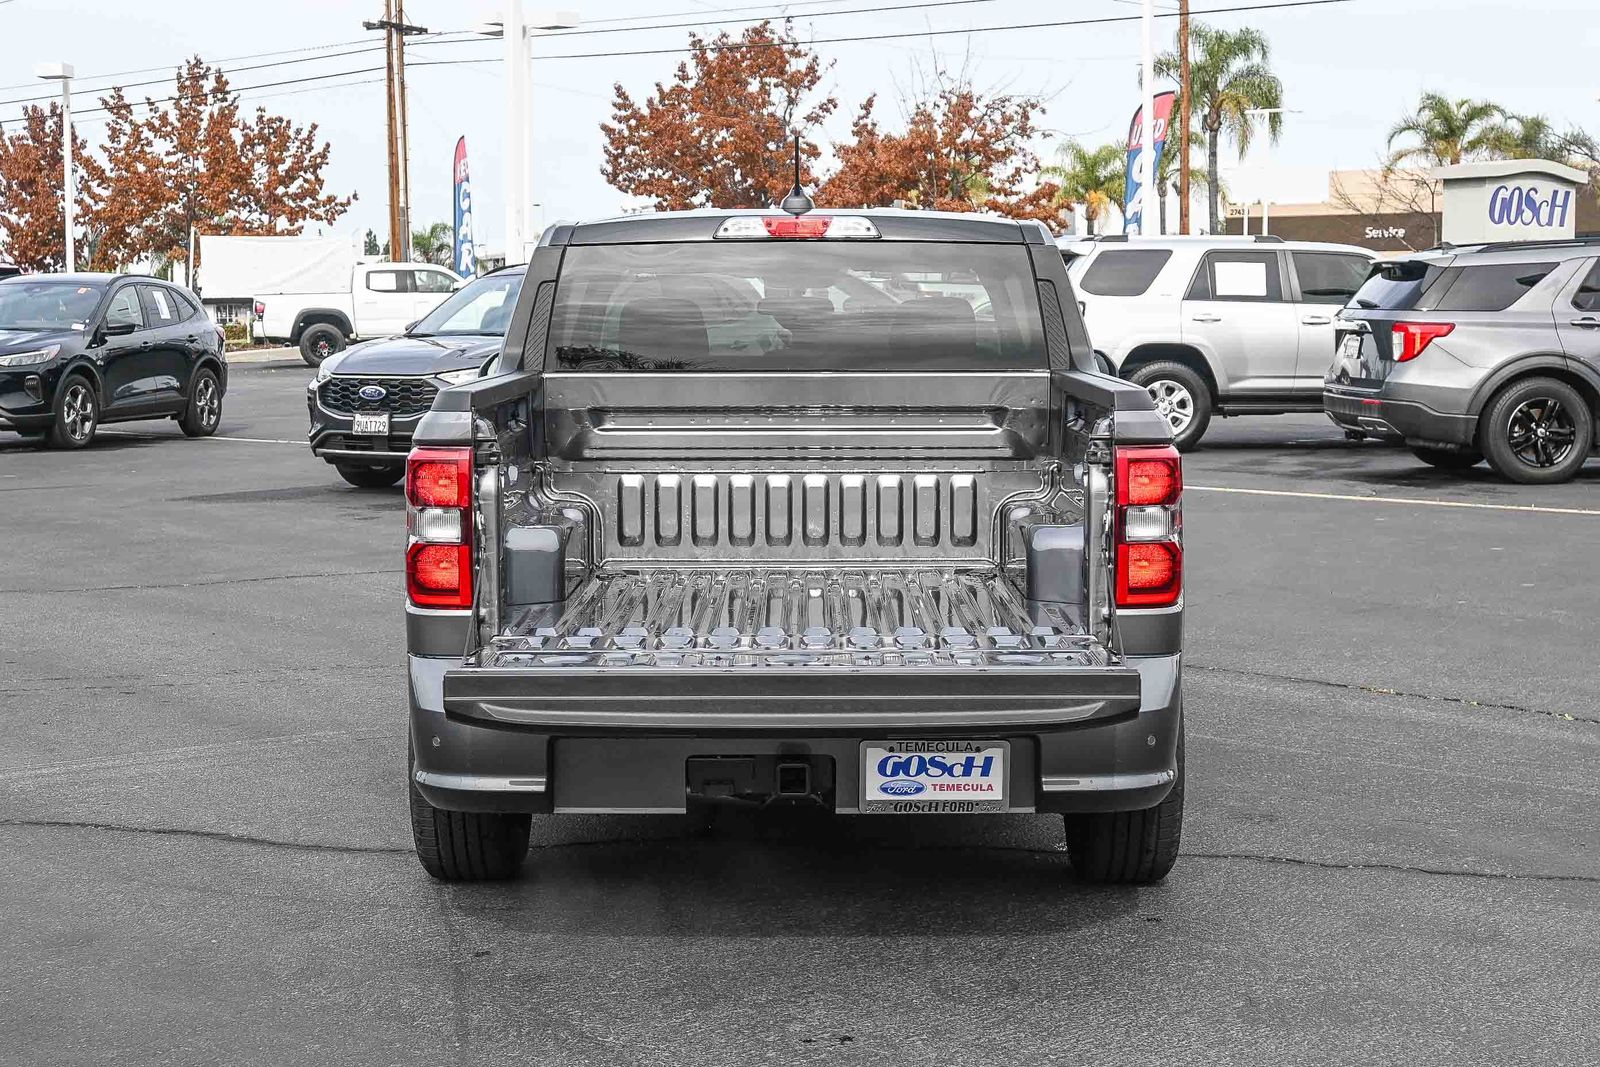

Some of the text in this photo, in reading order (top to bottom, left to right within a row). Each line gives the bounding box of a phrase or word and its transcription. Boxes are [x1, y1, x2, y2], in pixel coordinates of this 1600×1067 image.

[1365, 226, 1406, 239] Service
[896, 741, 974, 753] TEMECULA
[886, 781, 918, 795] Ford
[930, 783, 994, 792] TEMECULA
[942, 801, 974, 812] FORD
